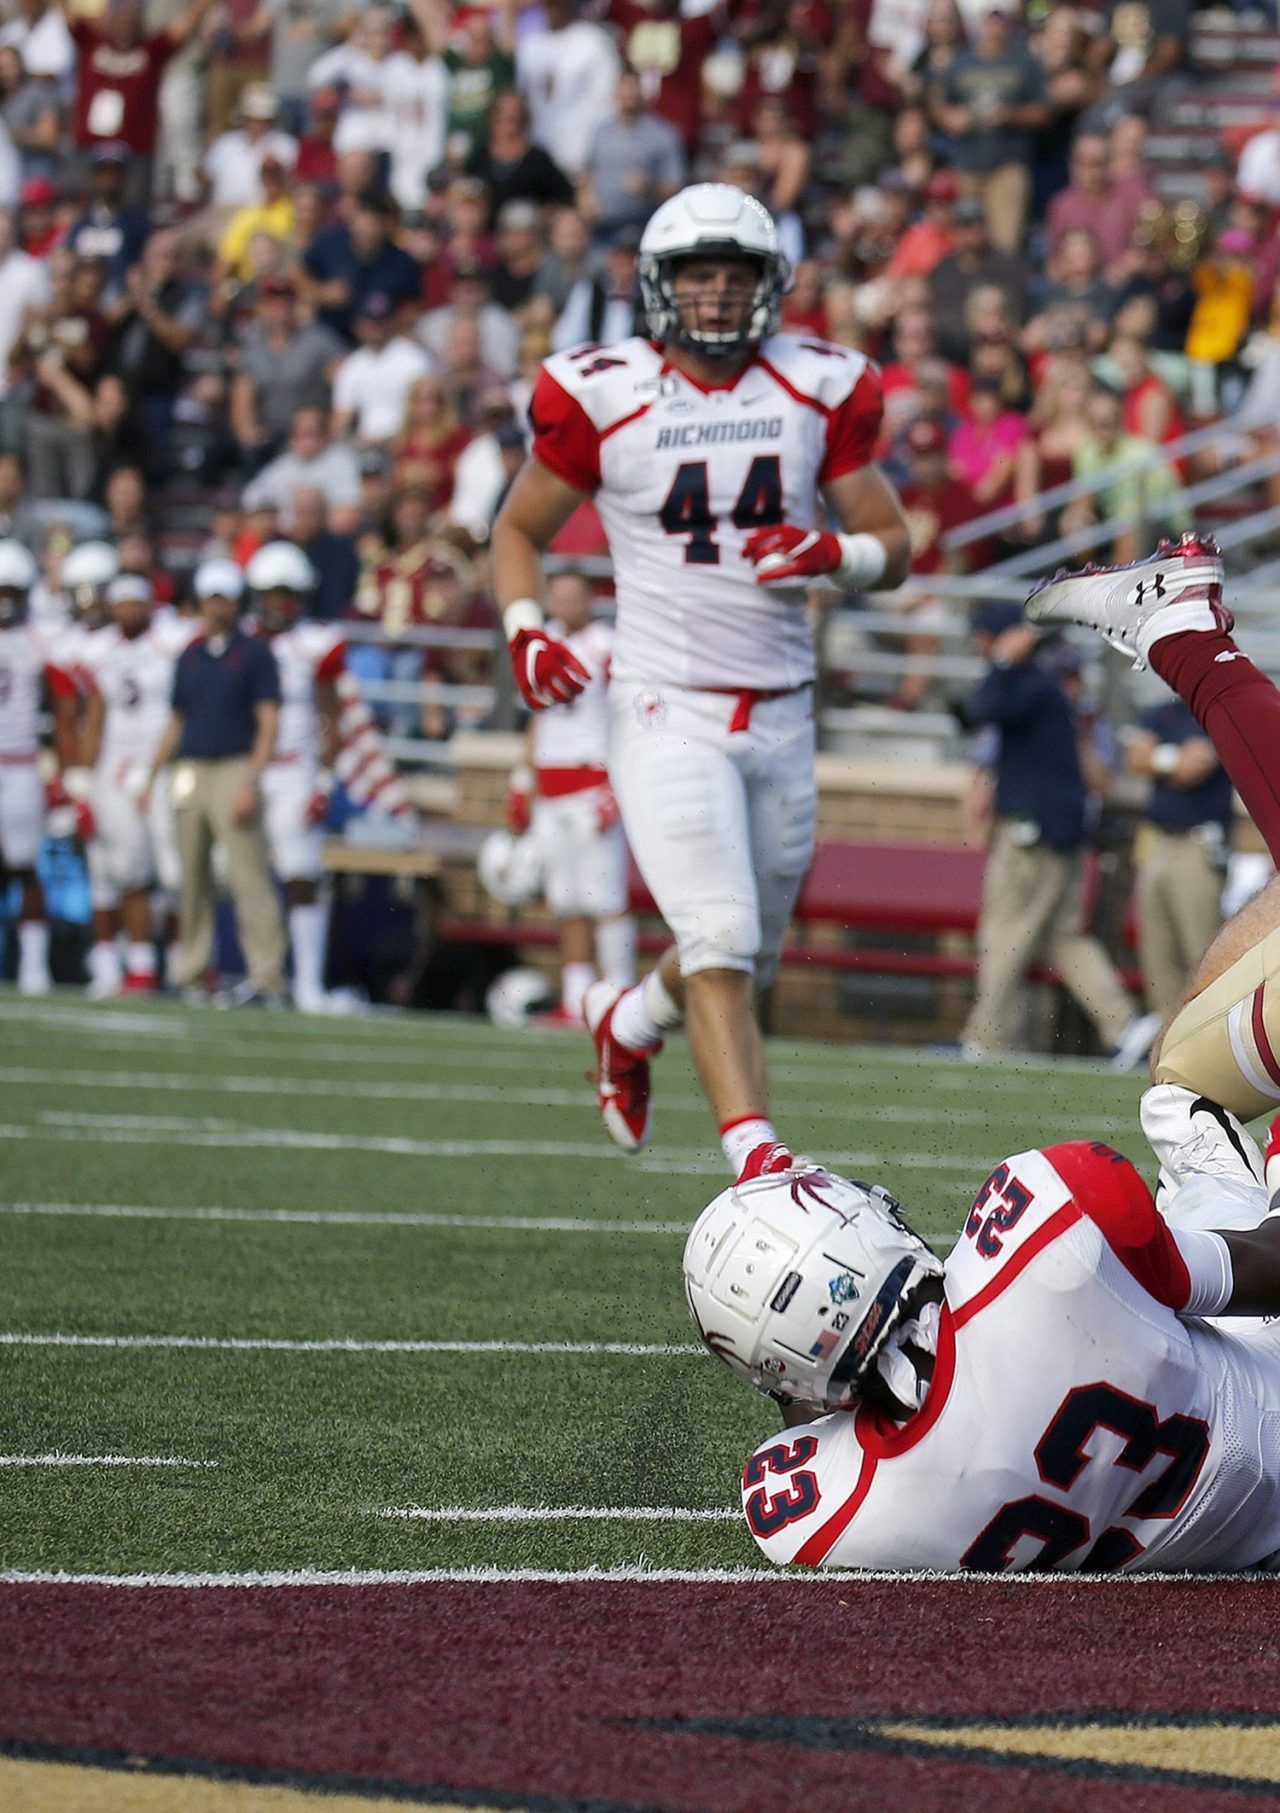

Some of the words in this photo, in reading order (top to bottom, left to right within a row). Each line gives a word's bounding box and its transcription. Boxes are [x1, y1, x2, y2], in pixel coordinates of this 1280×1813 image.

[656, 416, 783, 450] RICHMOND
[658, 455, 785, 565] 44
[965, 1162, 1035, 1260] 23
[742, 1435, 822, 1540] 23
